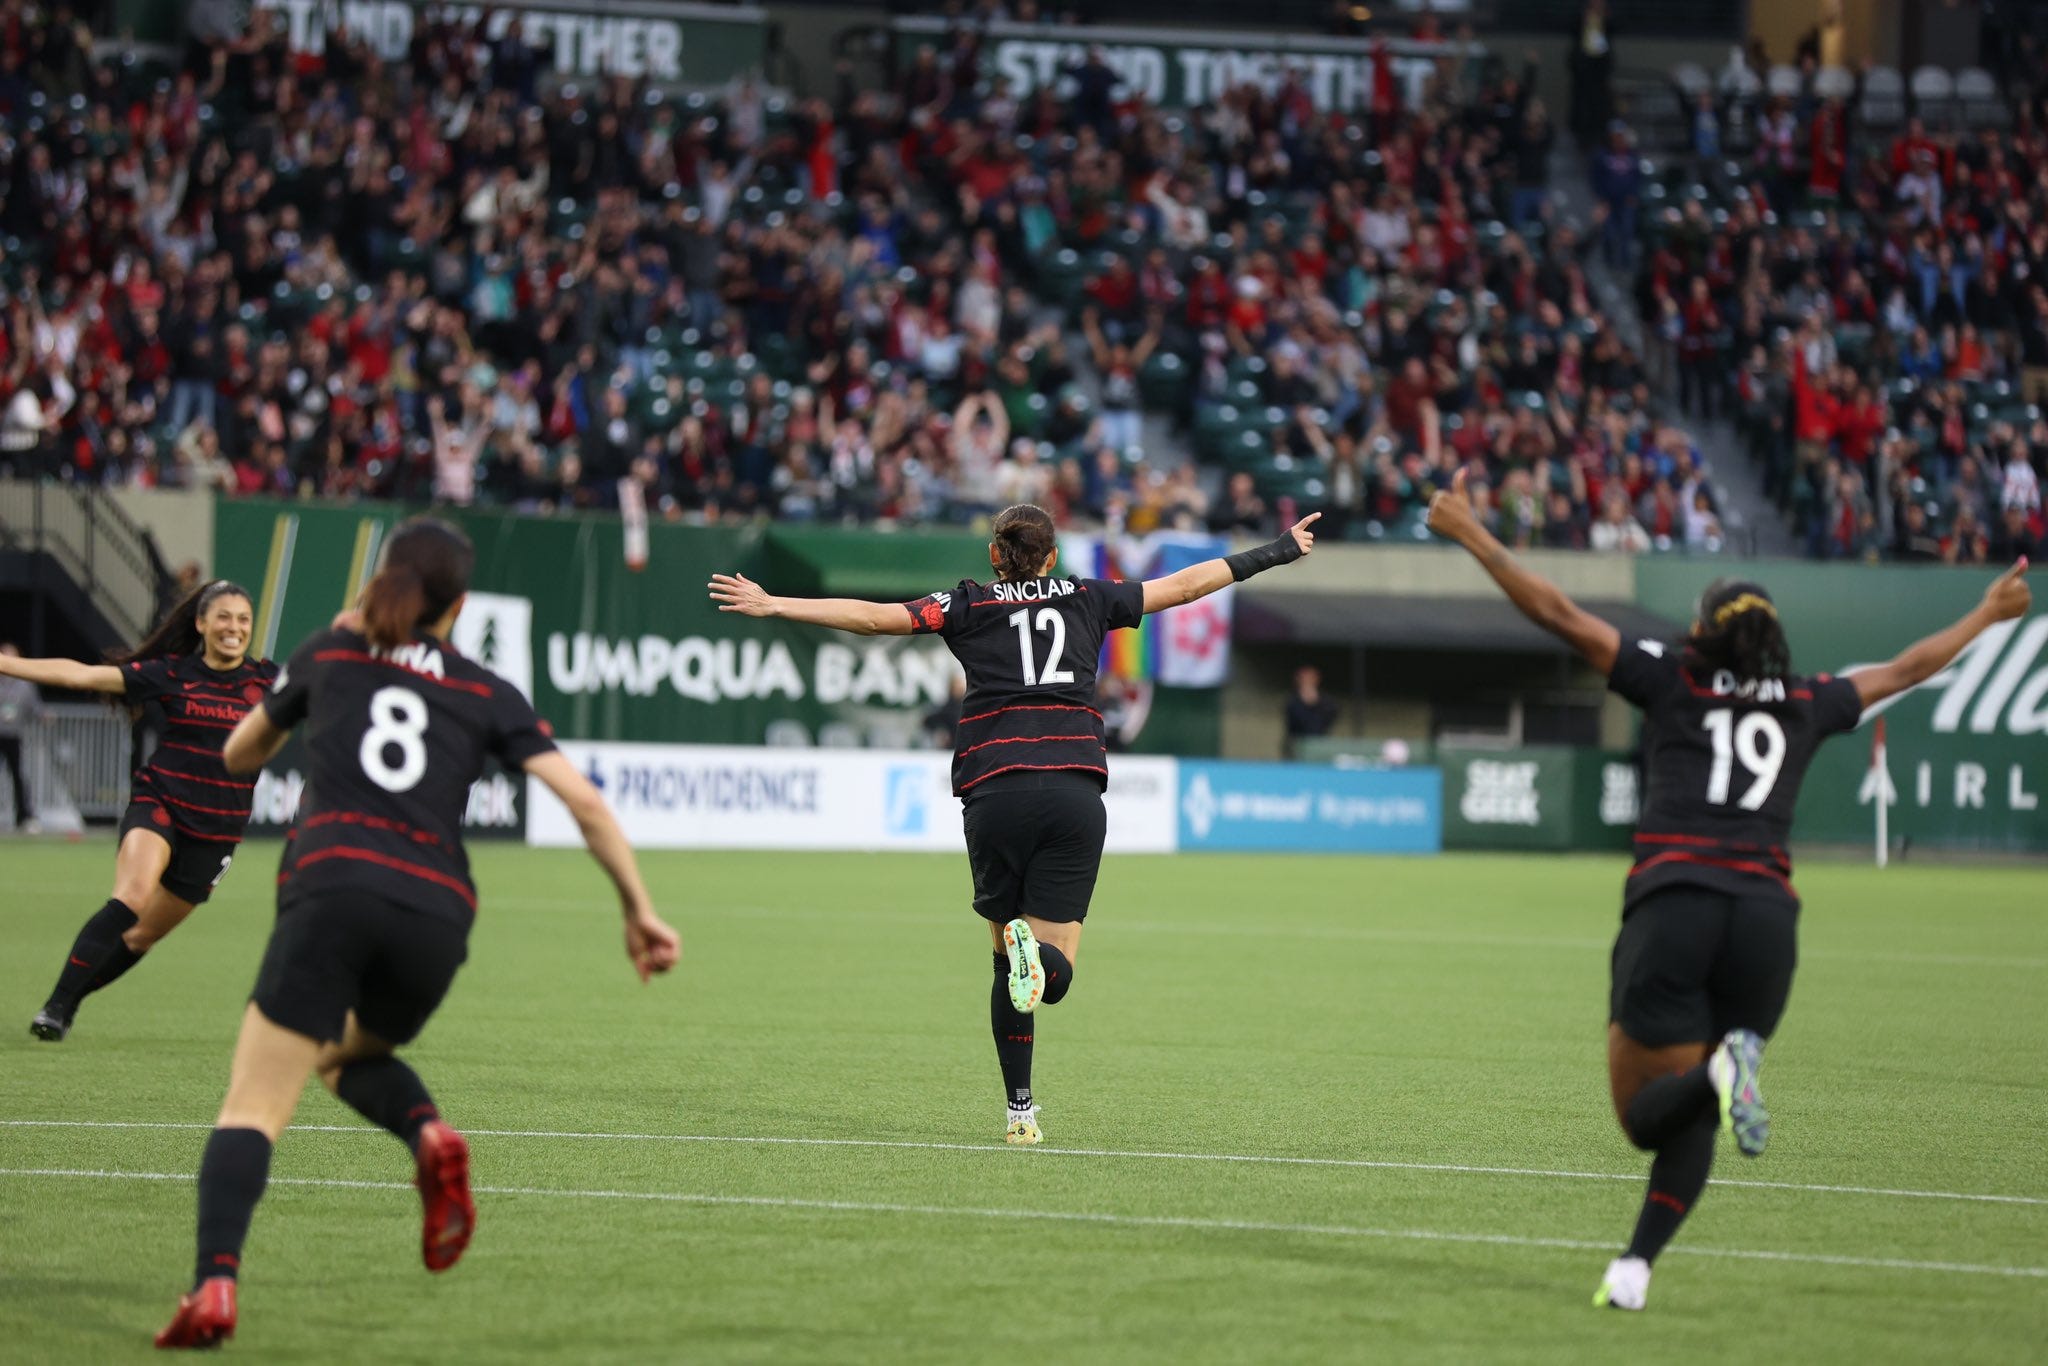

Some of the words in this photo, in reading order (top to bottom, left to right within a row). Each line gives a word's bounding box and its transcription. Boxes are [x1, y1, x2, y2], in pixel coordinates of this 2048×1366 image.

[993, 578, 1076, 602] SINCLAIR
[547, 632, 805, 703] UMPQUA
[814, 643, 957, 704] BAN
[1008, 607, 1076, 687] 12
[359, 685, 429, 794] 8
[1701, 707, 1787, 812] 19
[615, 763, 819, 815] PROVIDENCE
